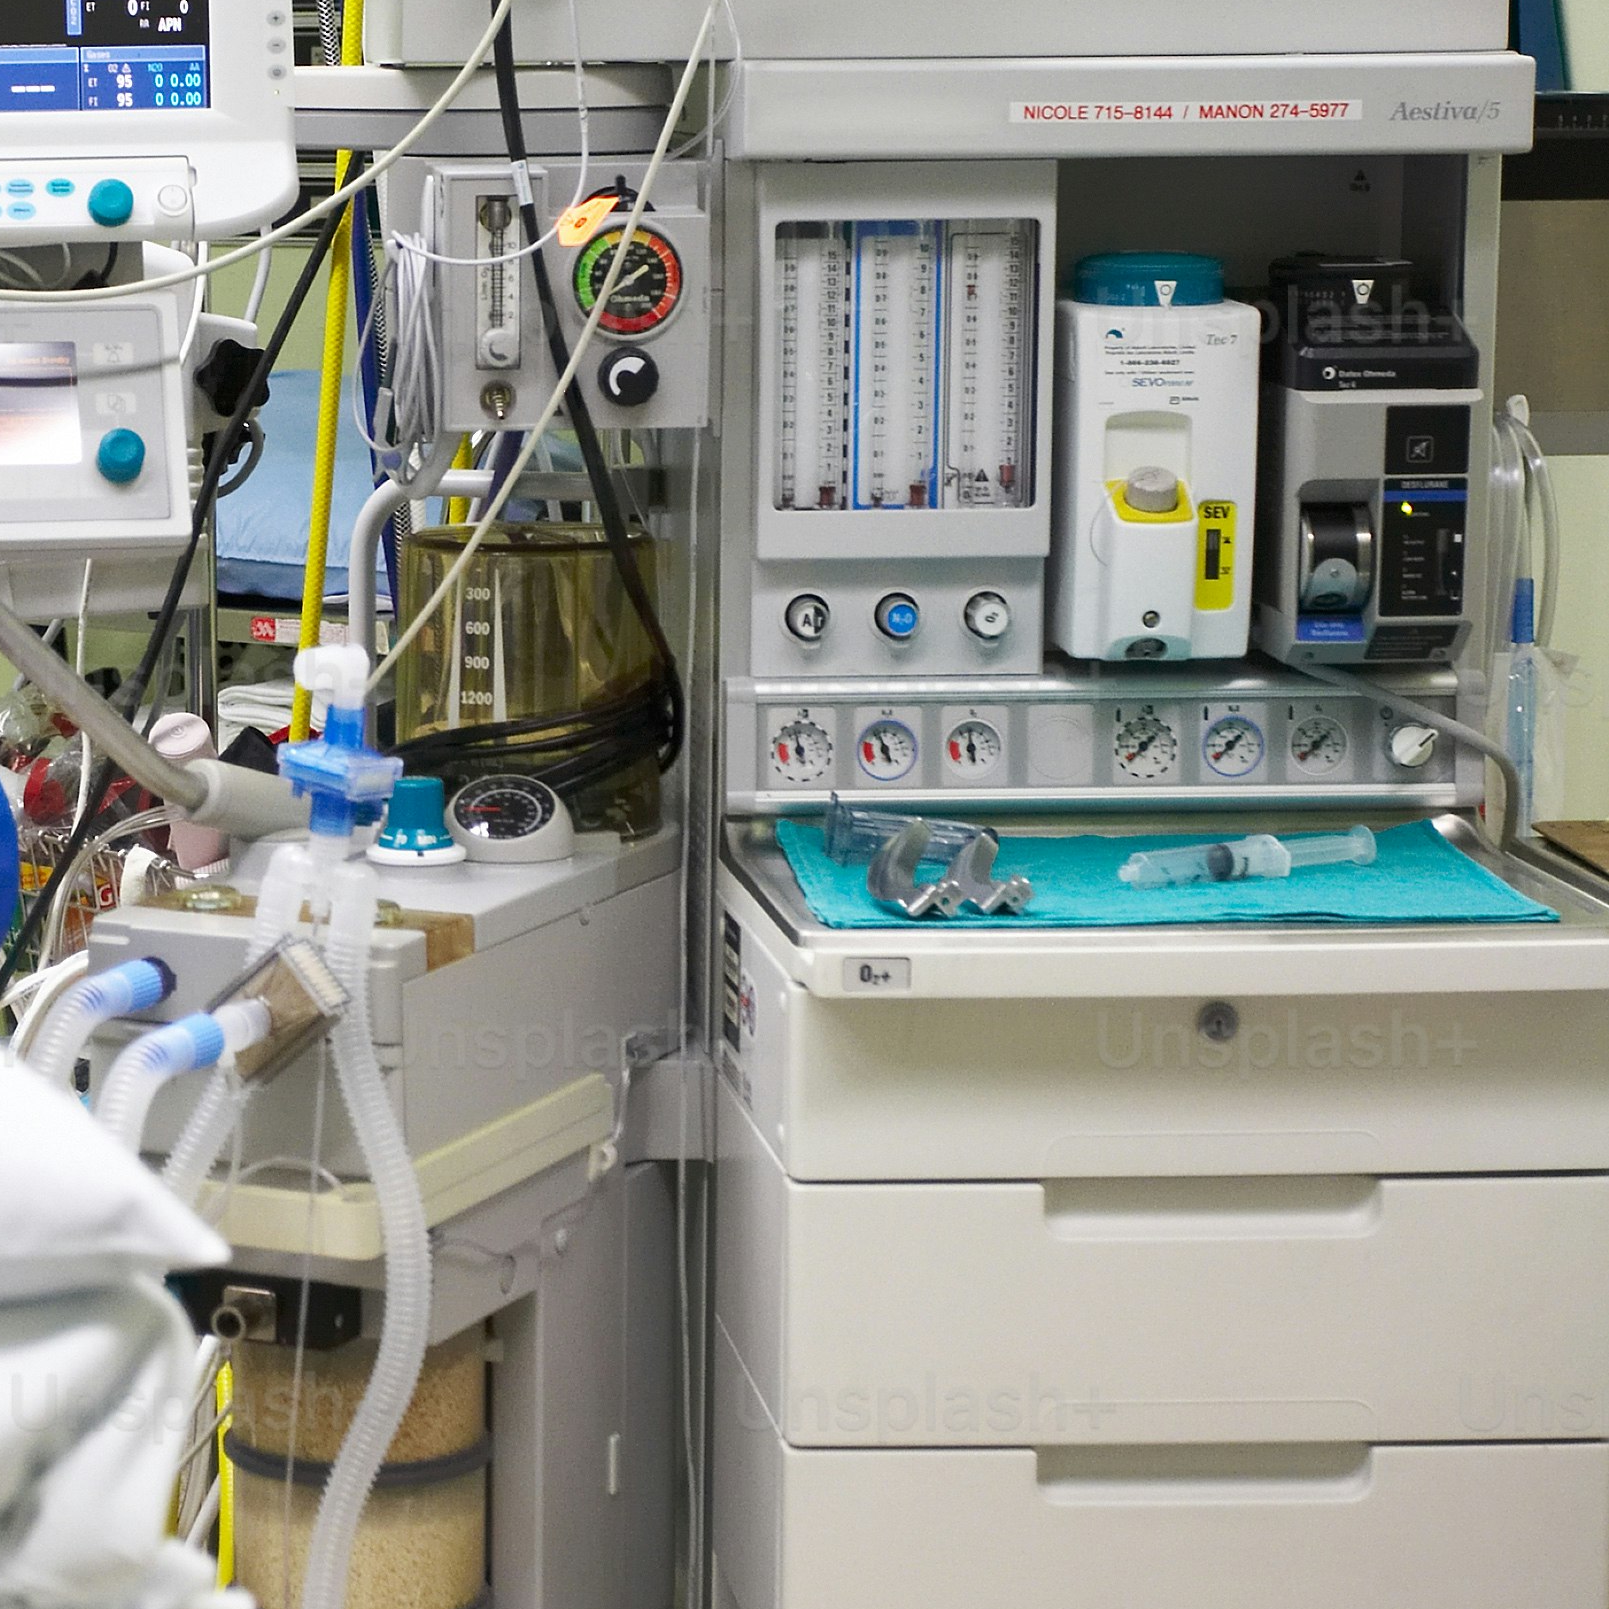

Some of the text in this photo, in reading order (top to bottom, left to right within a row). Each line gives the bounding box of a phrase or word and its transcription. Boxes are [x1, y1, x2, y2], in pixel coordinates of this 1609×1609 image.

[86, 2, 95, 12] ET
[140, 1, 149, 10] FI
[180, 0, 189, 14] 0
[158, 18, 182, 31] APN
[117, 75, 132, 88] 95
[155, 74, 163, 87] 0
[170, 74, 200, 87] 0.00
[117, 93, 133, 107] 95
[156, 93, 163, 105] 0
[171, 93, 201, 105] 0.00
[1023, 103, 1349, 120] NICOLE 715-8144 / MANON 274-5977
[1389, 99, 1501, 123] Aestiva/5
[1206, 334, 1238, 345] Tec 7
[1204, 506, 1230, 518] SEV
[466, 587, 490, 600] 300
[465, 621, 490, 635] 600
[464, 656, 490, 670] 900
[461, 691, 492, 705] 1200
